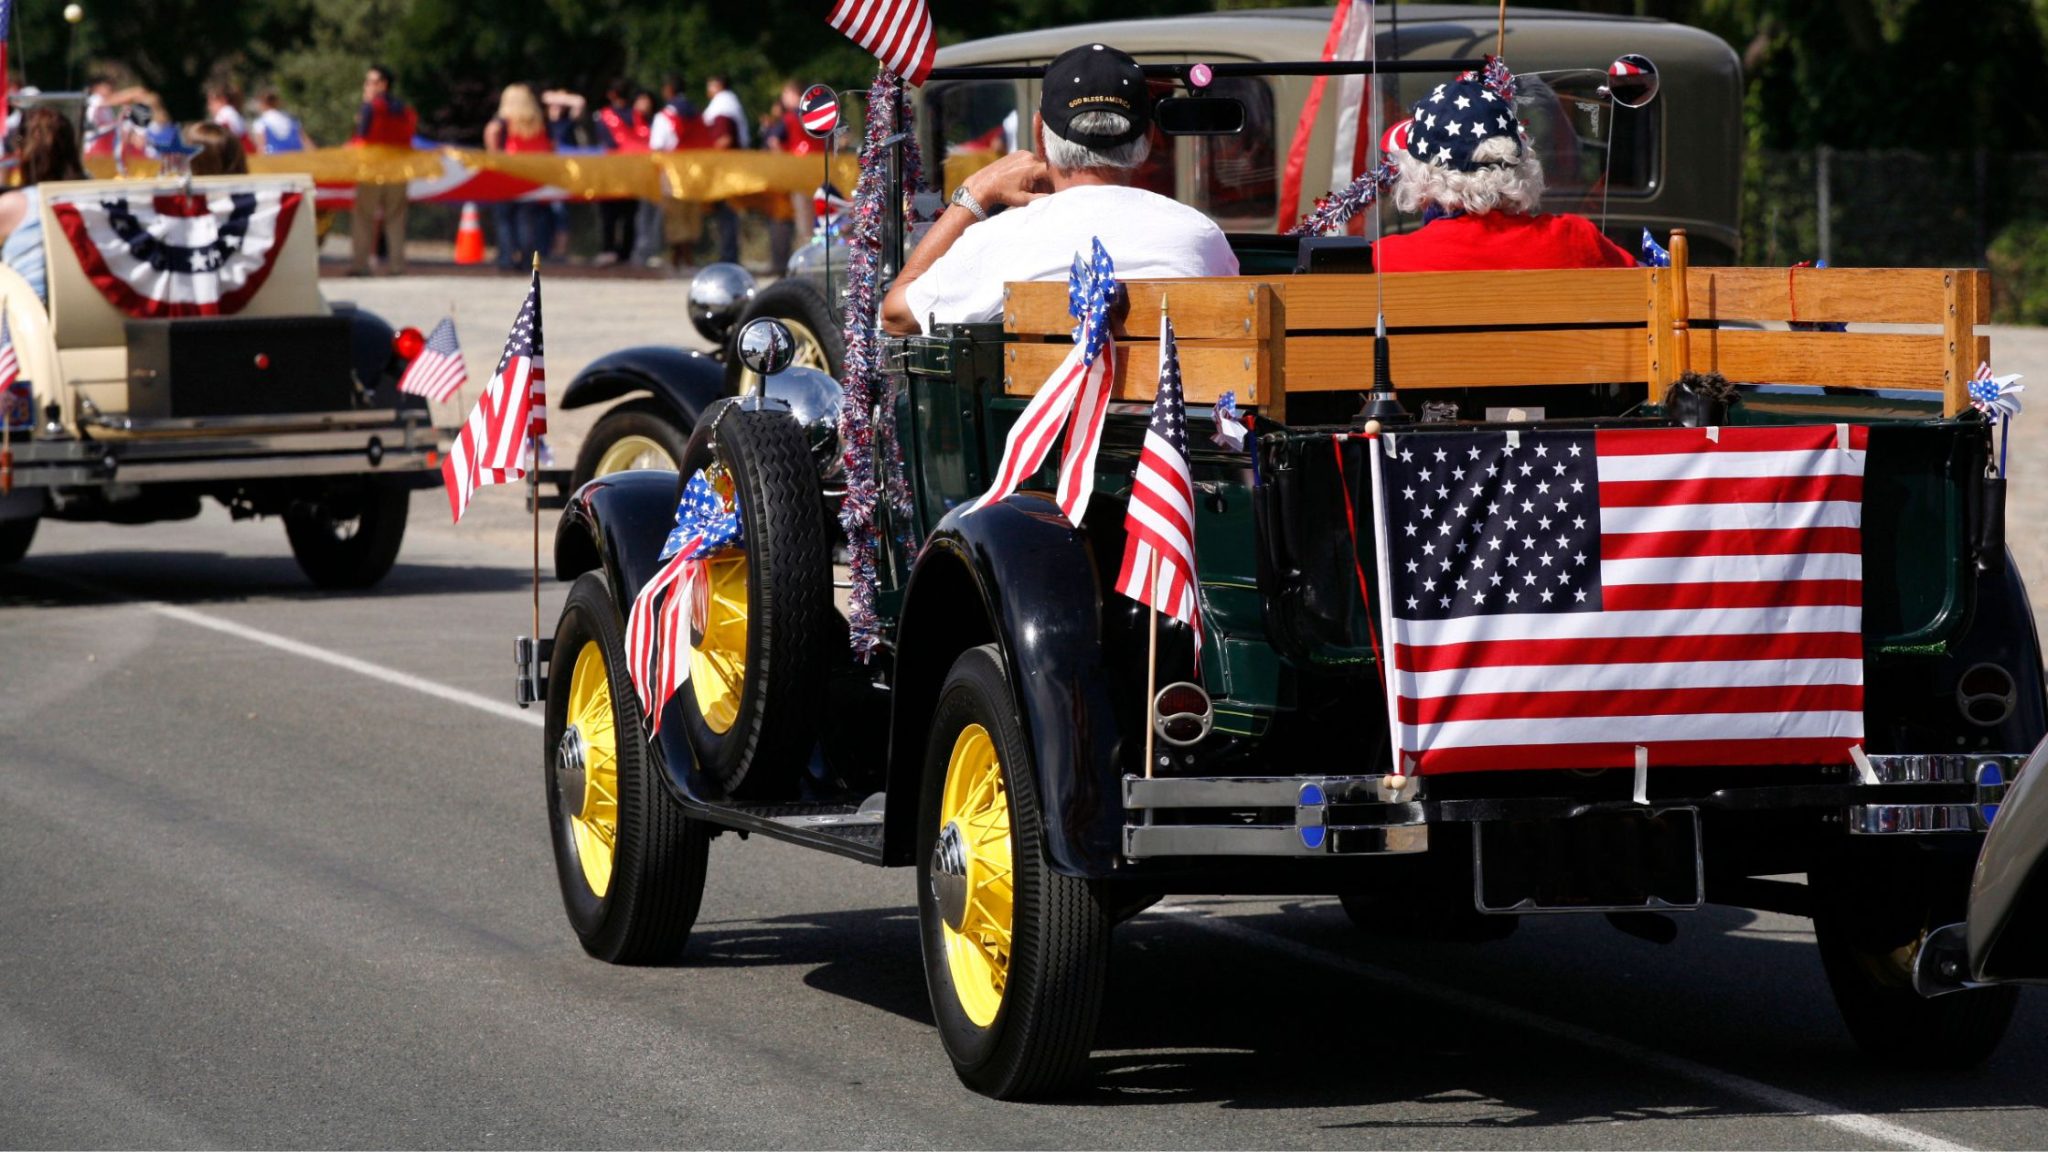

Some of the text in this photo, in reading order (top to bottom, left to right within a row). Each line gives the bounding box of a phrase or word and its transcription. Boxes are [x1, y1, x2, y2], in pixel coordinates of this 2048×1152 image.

[1068, 95, 1131, 109] GOD BLESS AMERICA
